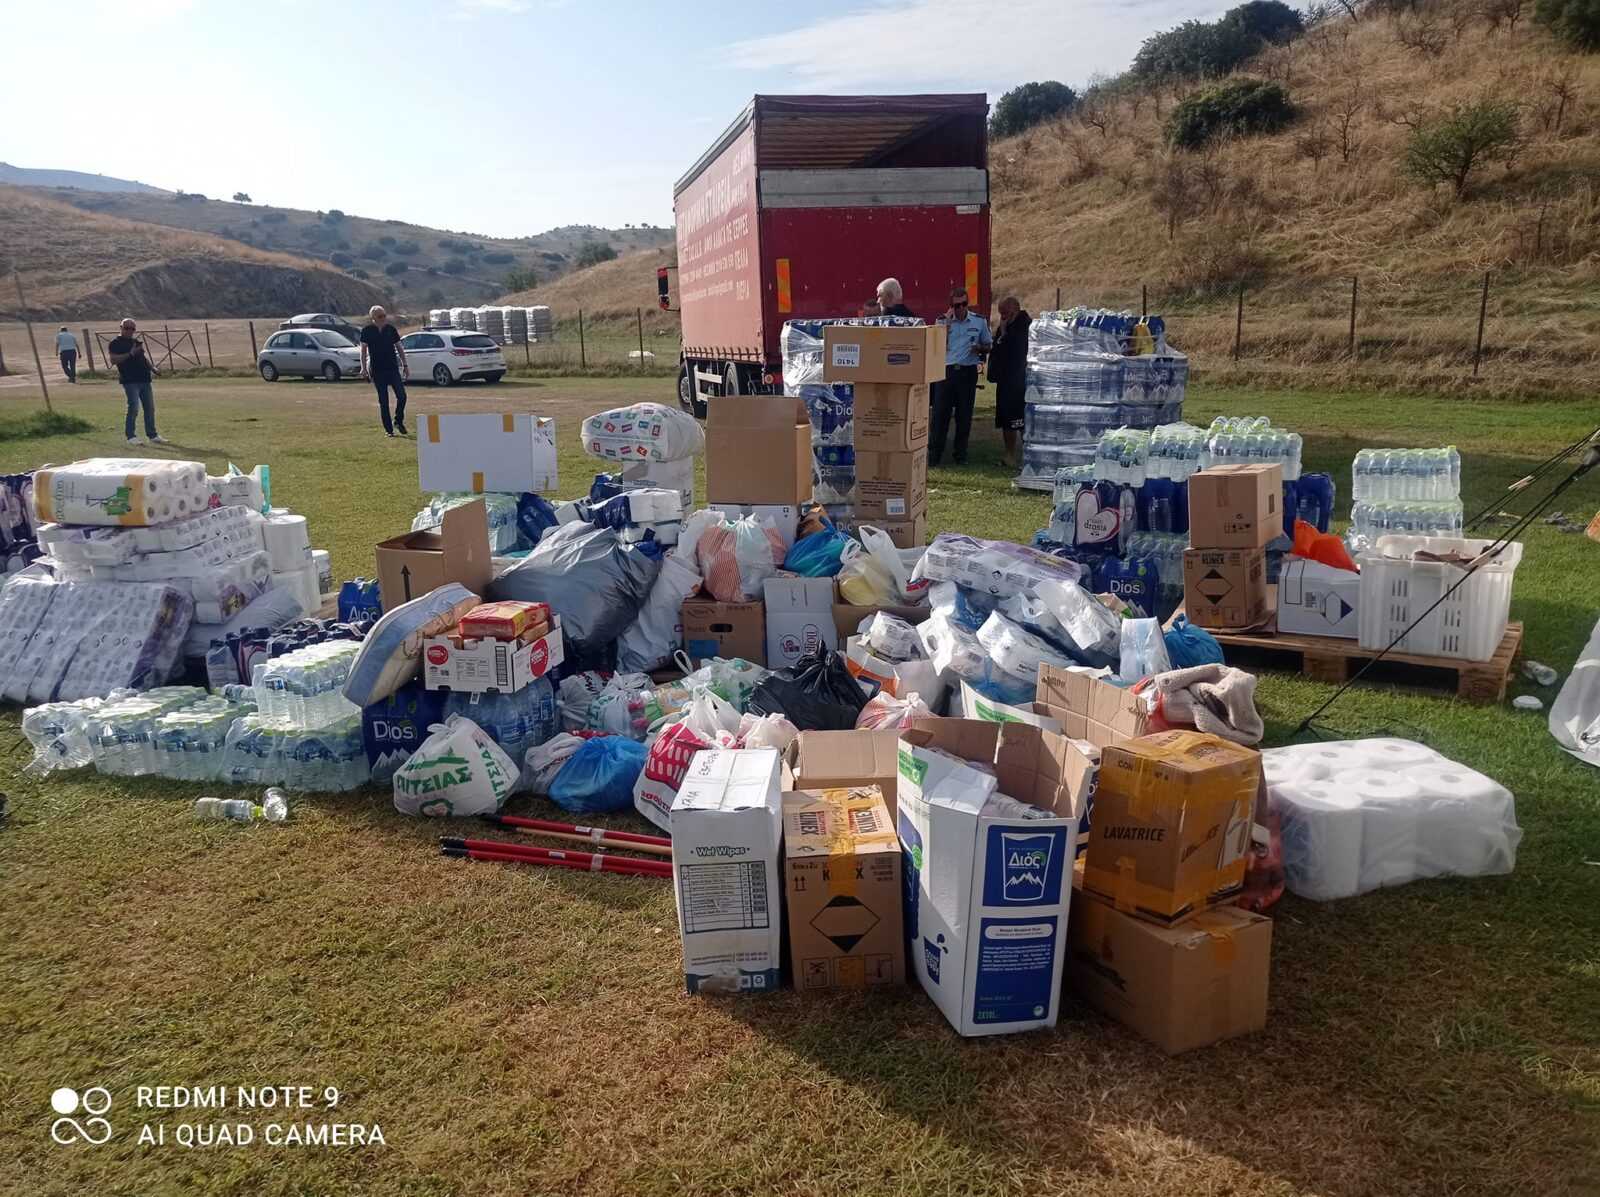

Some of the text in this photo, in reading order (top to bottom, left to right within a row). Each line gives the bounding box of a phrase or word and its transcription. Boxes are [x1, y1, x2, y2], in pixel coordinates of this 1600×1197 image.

[835, 405, 853, 416] Dio
[1110, 580, 1141, 593] Dios
[373, 720, 415, 741] Dios
[1103, 825, 1167, 842] LAVATRICE
[696, 846, 746, 857] Wet Wipes
[1008, 851, 1041, 870] Διός
